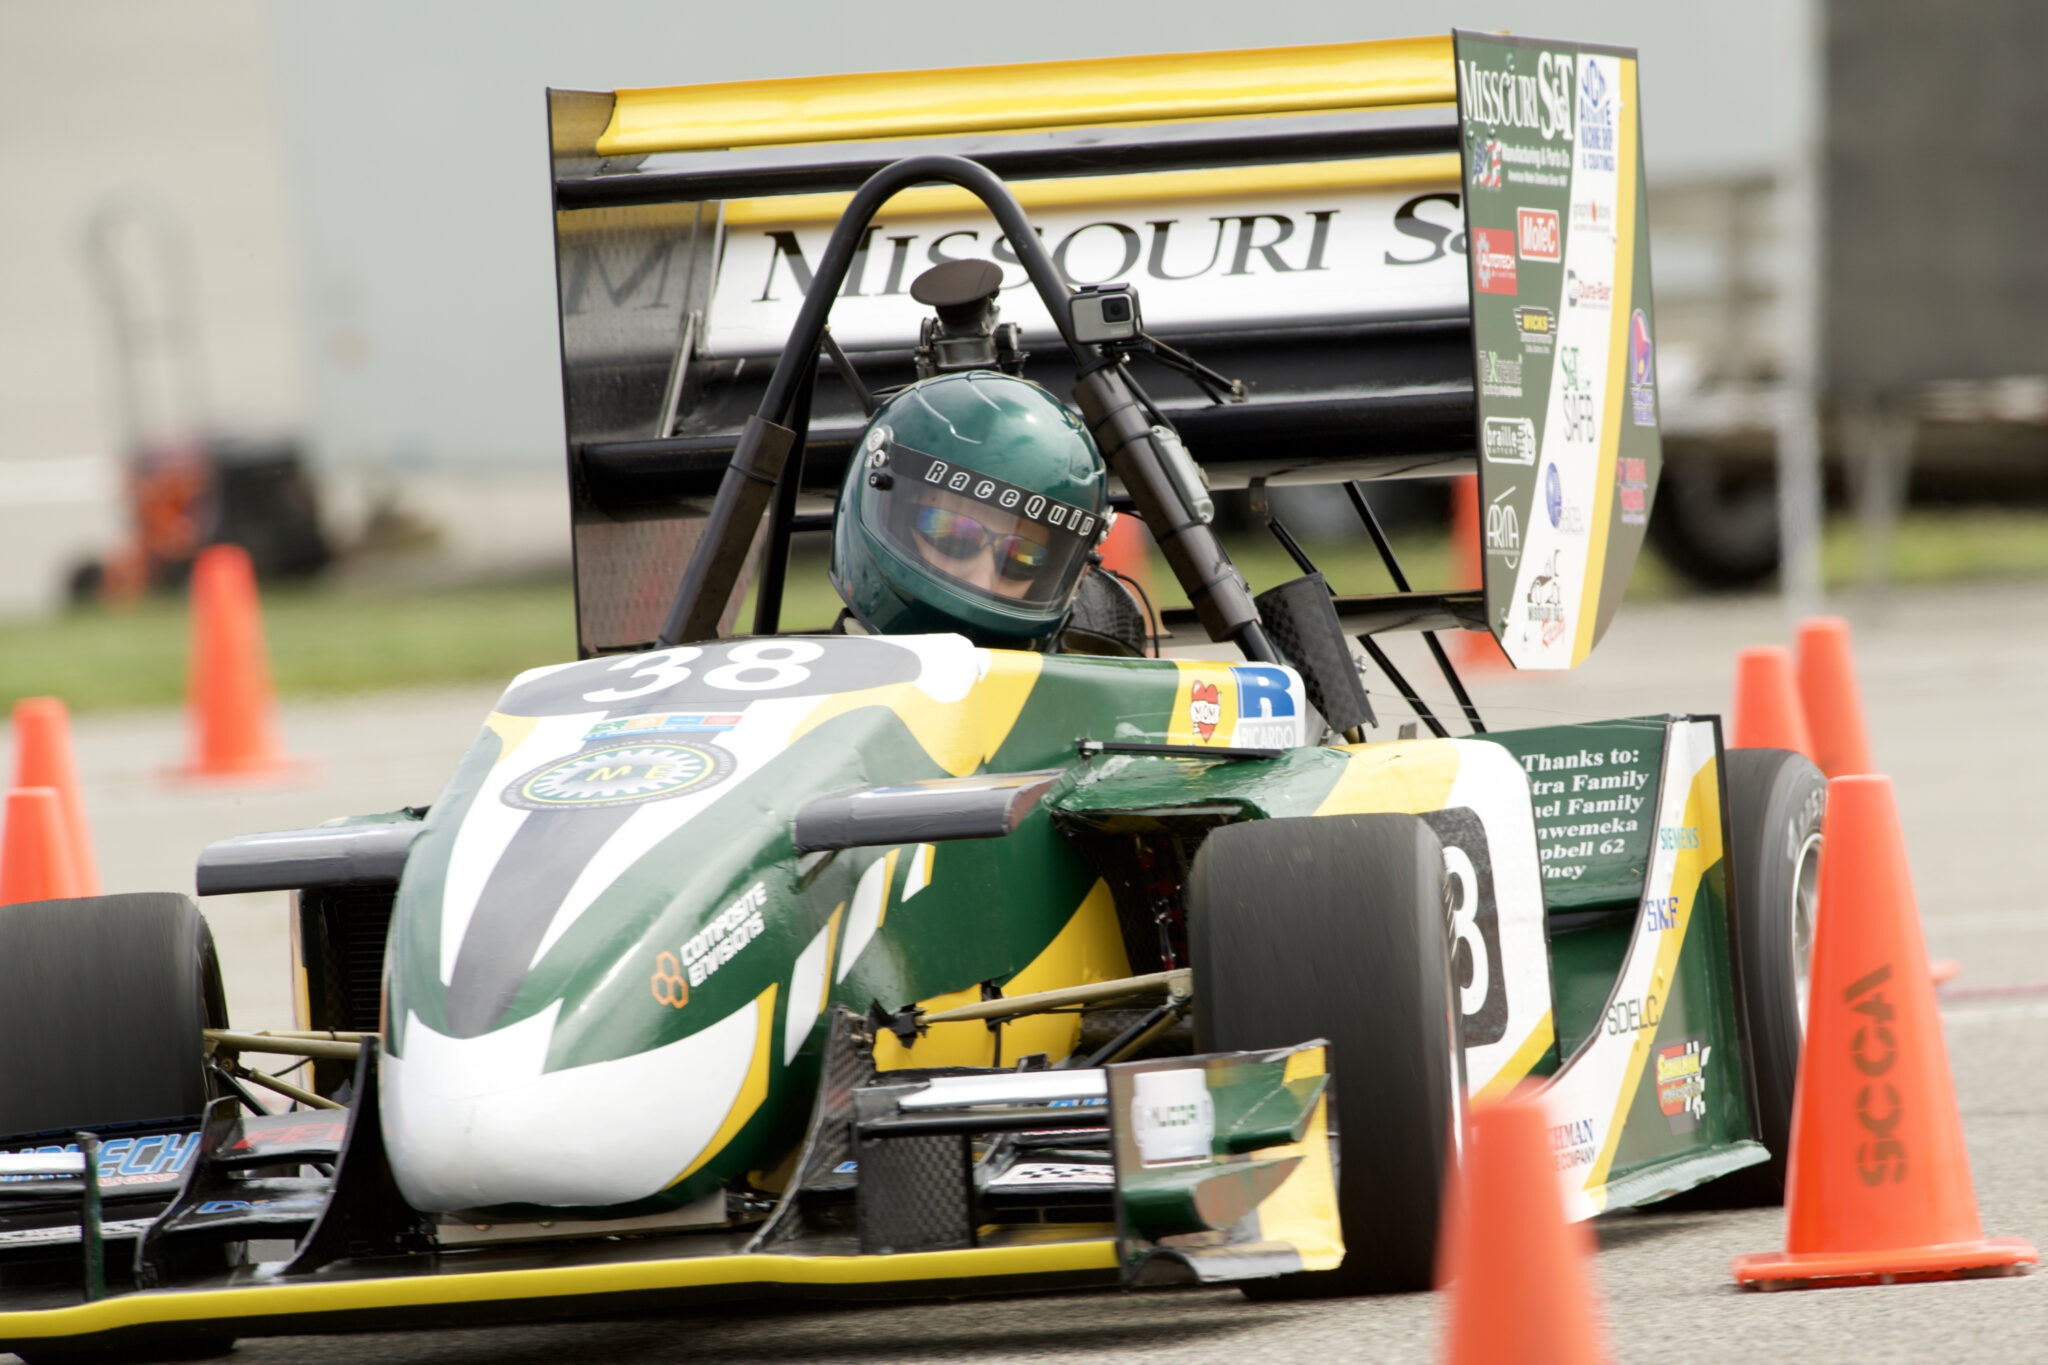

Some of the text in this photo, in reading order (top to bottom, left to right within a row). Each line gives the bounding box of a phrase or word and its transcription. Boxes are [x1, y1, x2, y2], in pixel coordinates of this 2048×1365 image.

[1459, 59, 1539, 128] MISSOURI
[1537, 51, 1574, 141] S&T
[924, 460, 1095, 536] RaceQuip
[582, 640, 825, 702] 38
[1240, 725, 1295, 749] RICARDO
[1521, 748, 1640, 773] Thanks to:
[1533, 770, 1650, 796] tra Family
[1566, 794, 1645, 815] Family
[1537, 818, 1638, 840] nwemeka
[1541, 838, 1626, 864] pbell 62
[1646, 896, 1679, 932] SKF
[1843, 963, 1908, 1188] SCCA
[1553, 1118, 1594, 1151] HMAN
